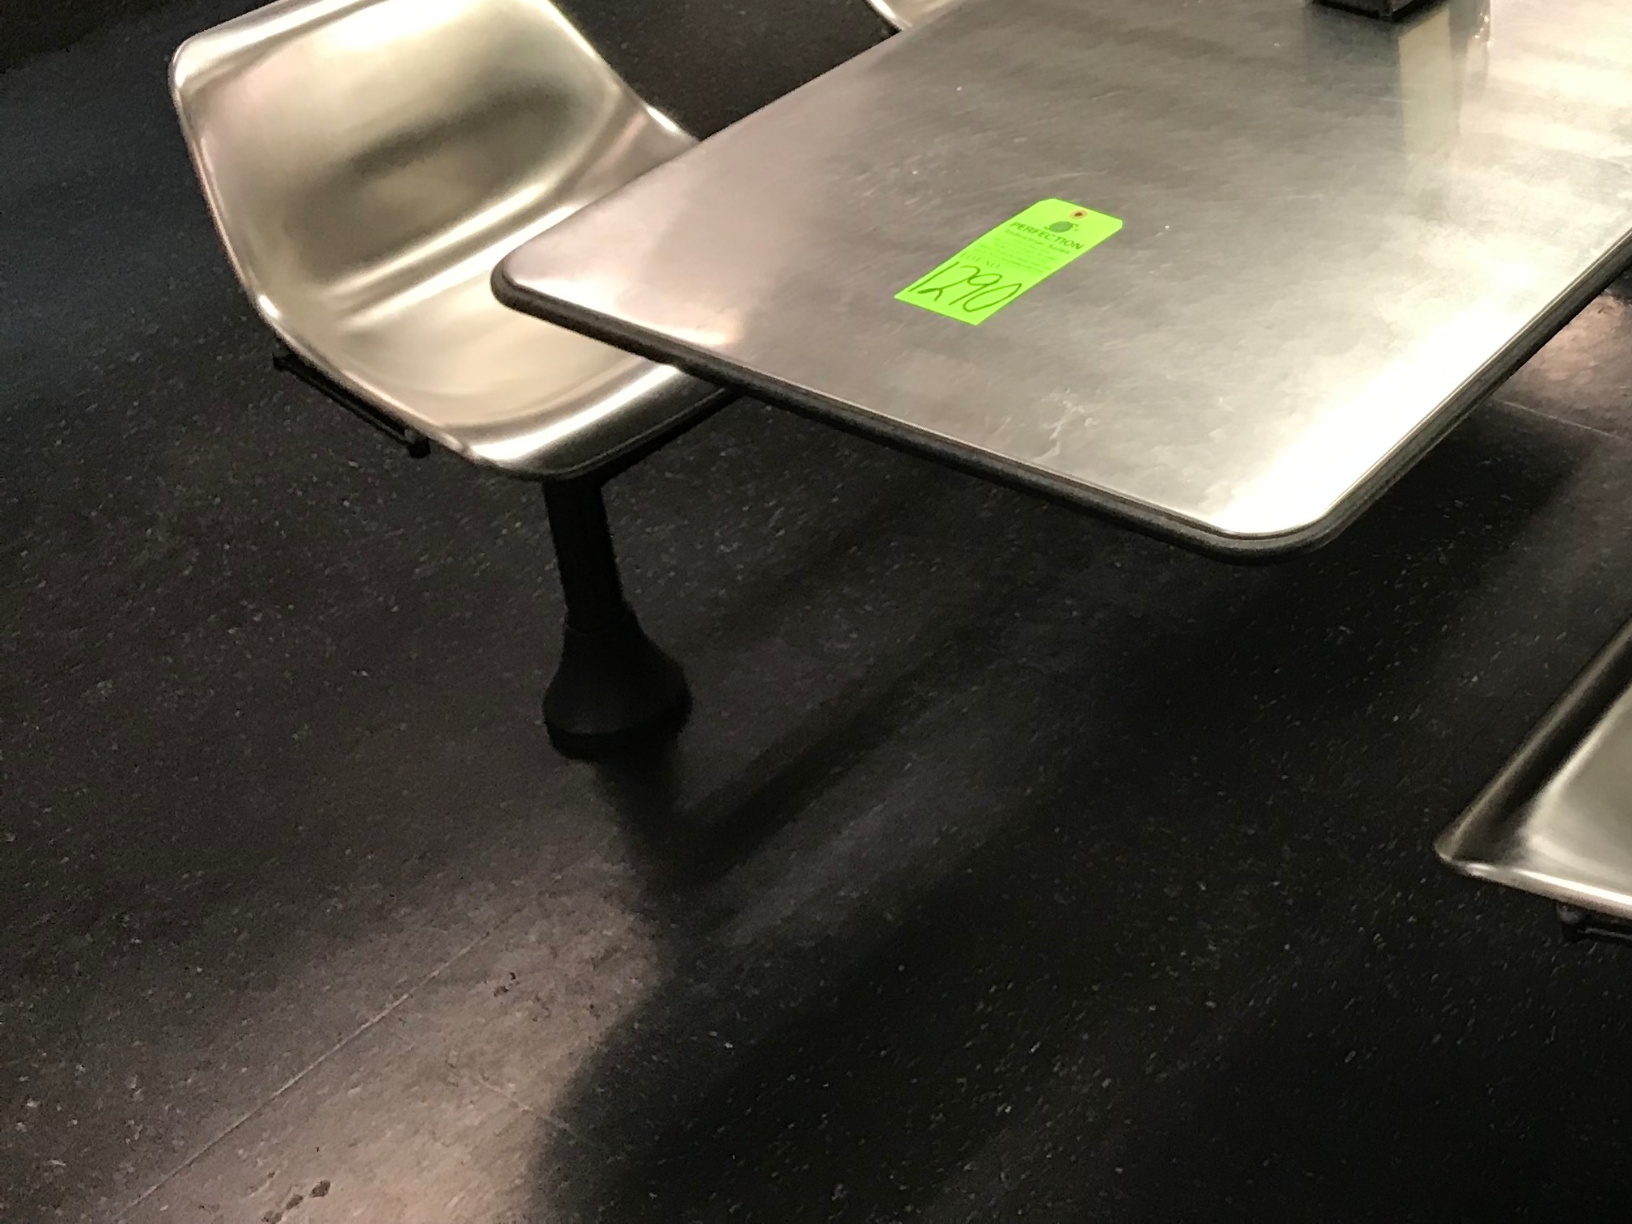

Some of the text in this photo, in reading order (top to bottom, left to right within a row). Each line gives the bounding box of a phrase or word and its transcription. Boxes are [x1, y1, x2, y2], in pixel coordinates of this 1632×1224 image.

[1009, 221, 1085, 251] PERFECTION
[1047, 242, 1070, 255] Sales
[907, 260, 1023, 313] 1290
